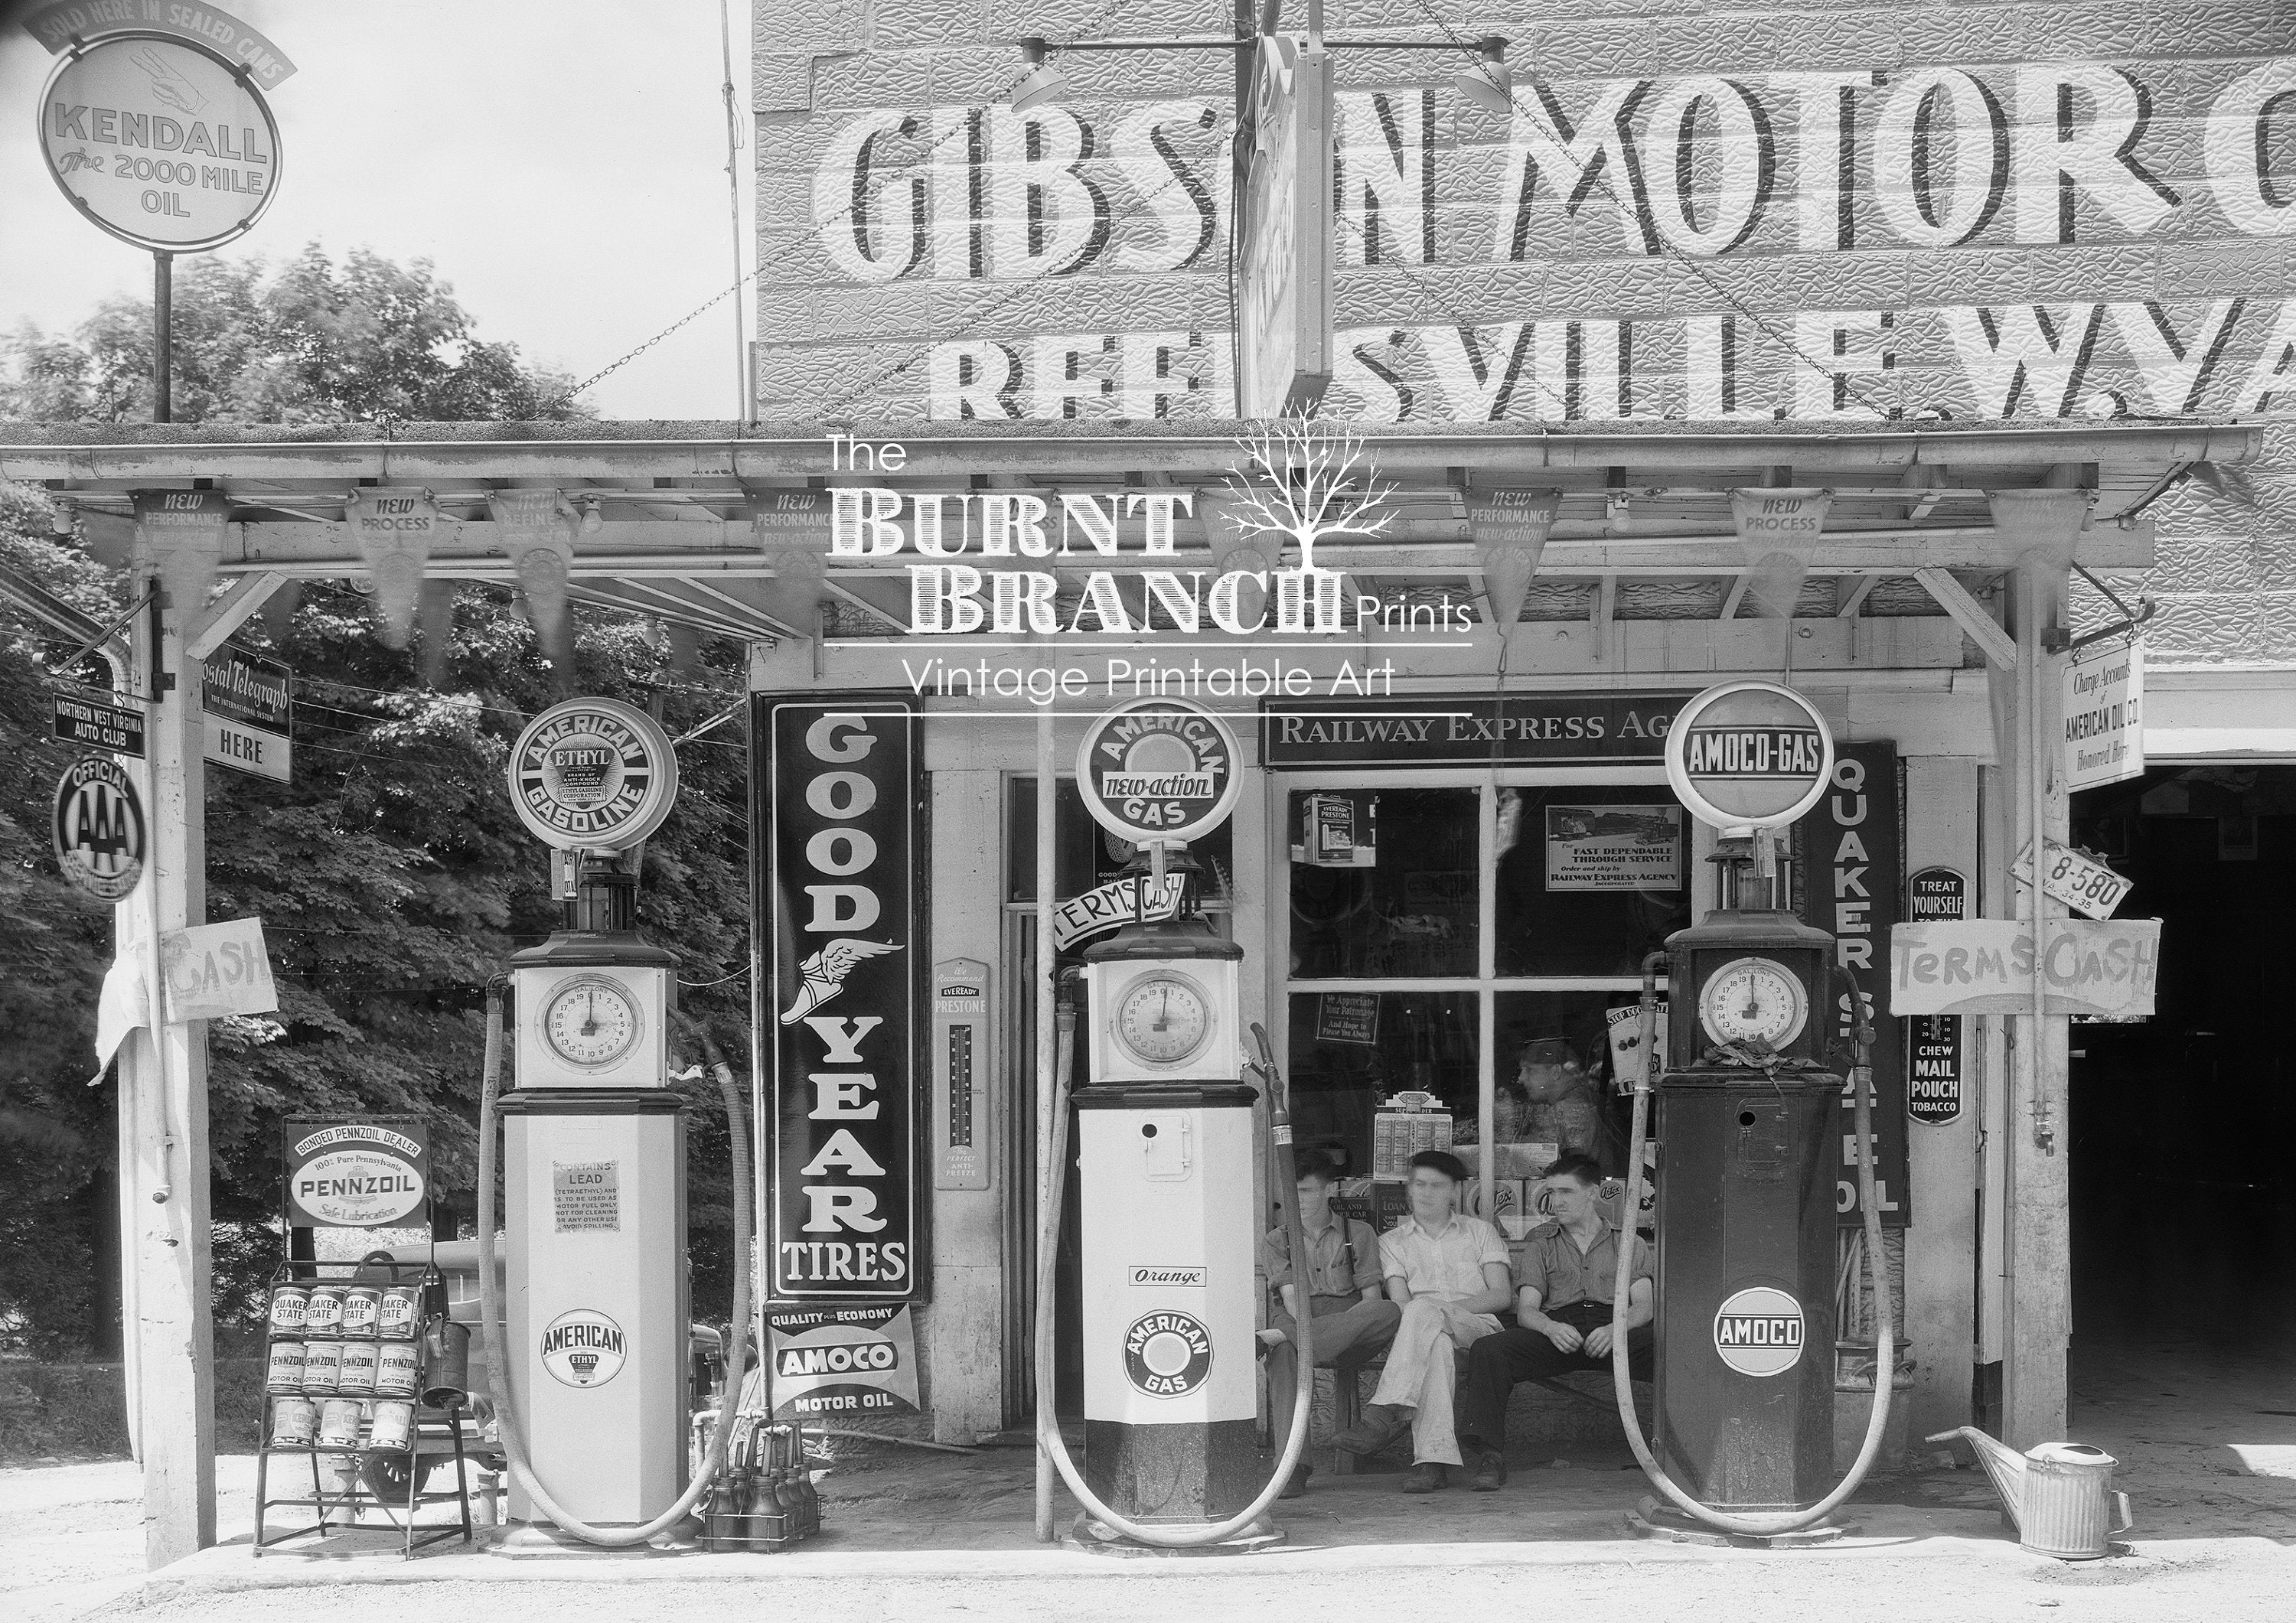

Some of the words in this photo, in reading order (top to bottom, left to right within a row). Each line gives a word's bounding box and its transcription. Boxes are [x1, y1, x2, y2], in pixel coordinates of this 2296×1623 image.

[41, 8, 86, 44] SOLD
[91, 0, 132, 24] HERE
[142, 0, 160, 21] IN
[168, 4, 234, 44] SEALED
[236, 38, 284, 79] CANS
[54, 102, 267, 165] KENDALL
[59, 147, 105, 175] The
[115, 154, 196, 187] 2000
[201, 165, 263, 196] MILE
[811, 90, 1436, 281] GIBSN
[1492, 67, 2183, 262] MOTOR
[141, 190, 191, 218] OIL
[165, 494, 203, 510] NEW
[377, 498, 414, 514] NEW
[777, 495, 816, 510] NEW
[1492, 491, 1531, 506] NEW
[1763, 499, 1802, 514] NEW
[145, 512, 223, 526] PERFORMANCE
[362, 517, 429, 530] PROCESS
[1471, 509, 1550, 523] PERFORMANCE
[1746, 517, 1816, 530] PROCESS
[202, 658, 231, 689] ostal
[232, 660, 288, 713] Telegraph
[2074, 672, 2099, 696] Charge
[2099, 658, 2131, 687] Accounts
[56, 699, 92, 723] NORTHERN
[93, 709, 111, 725] WEST
[113, 712, 142, 734] VIRGINIA
[211, 694, 220, 705] THE
[220, 698, 256, 718] INTERNATIONAL
[256, 709, 274, 723] SYSTEM
[1279, 715, 1436, 744] RAILWAY
[1446, 715, 1605, 742] EXPRESS
[2066, 707, 2108, 743] AMERICAN
[2112, 702, 2125, 730] OIL
[2128, 698, 2139, 725] CO.
[74, 722, 99, 741] AUTO
[103, 730, 126, 747] CLUB
[527, 715, 644, 763] AMERICAN
[1101, 709, 1225, 774] AMERICAN
[220, 728, 263, 764] HERE
[1688, 732, 1819, 772] AMOCO-GAS
[555, 749, 610, 766] ETHYL
[2077, 743, 2110, 772] Honored
[2112, 741, 2130, 763] Here
[73, 761, 129, 799] OFFICIAL
[1106, 773, 1212, 798] new-action
[527, 783, 644, 832] GASOLINE
[1122, 797, 1187, 826] GAS
[77, 784, 129, 872] AAA
[1831, 758, 1874, 970] QUAKER
[1919, 881, 1956, 892] TREAT
[1913, 896, 1963, 914] YOURSELF
[2062, 891, 2092, 909] 34-35
[937, 973, 985, 983] Recommend
[954, 966, 967, 975] We
[575, 986, 608, 994] GALLONS
[935, 999, 987, 1013] PRESTONE
[1336, 995, 1374, 1007] Appreciate
[1326, 1005, 1341, 1014] Your
[1341, 1006, 1375, 1020] Patronage
[1607, 1012, 1625, 1026] STOP
[1329, 1020, 1342, 1028] And
[1343, 1021, 1358, 1030] Hope
[1352, 1030, 1370, 1040] Always
[1919, 1046, 1953, 1056] CHEW
[1916, 1060, 1955, 1077] MAIL
[1911, 1080, 1958, 1098] POUCH
[1911, 1102, 1956, 1112] TOBACCO
[298, 1130, 334, 1154] BONDED
[335, 1127, 380, 1141] PENNZOIL
[383, 1132, 419, 1155] DEALER
[355, 1155, 403, 1172] Pennsylvania
[560, 1163, 611, 1172] CONTAINS
[301, 1175, 416, 1198] PENNZOIL
[569, 1174, 603, 1184] LEAD
[319, 1203, 341, 1217] Safe
[341, 1207, 397, 1221] Lubrication
[1383, 1201, 1406, 1211] LOAN
[781, 1241, 906, 1282] TIRES
[1134, 1269, 1201, 1286] Orange
[275, 1299, 308, 1312] QUAKER
[277, 1310, 303, 1320] STATE
[771, 1312, 824, 1327] QUALITY
[837, 1307, 893, 1322] ECONOMY
[543, 1325, 622, 1355] AMERICAN
[1127, 1315, 1208, 1355] AMERICAN
[1720, 1319, 1799, 1345] AMOCO
[271, 1356, 305, 1367] PENNZOIL
[572, 1355, 597, 1364] ETHYL
[781, 1344, 895, 1377] AMOCO
[1144, 1374, 1187, 1393] GAS
[795, 1395, 859, 1413] MOTOR
[863, 1393, 895, 1408] OIL
